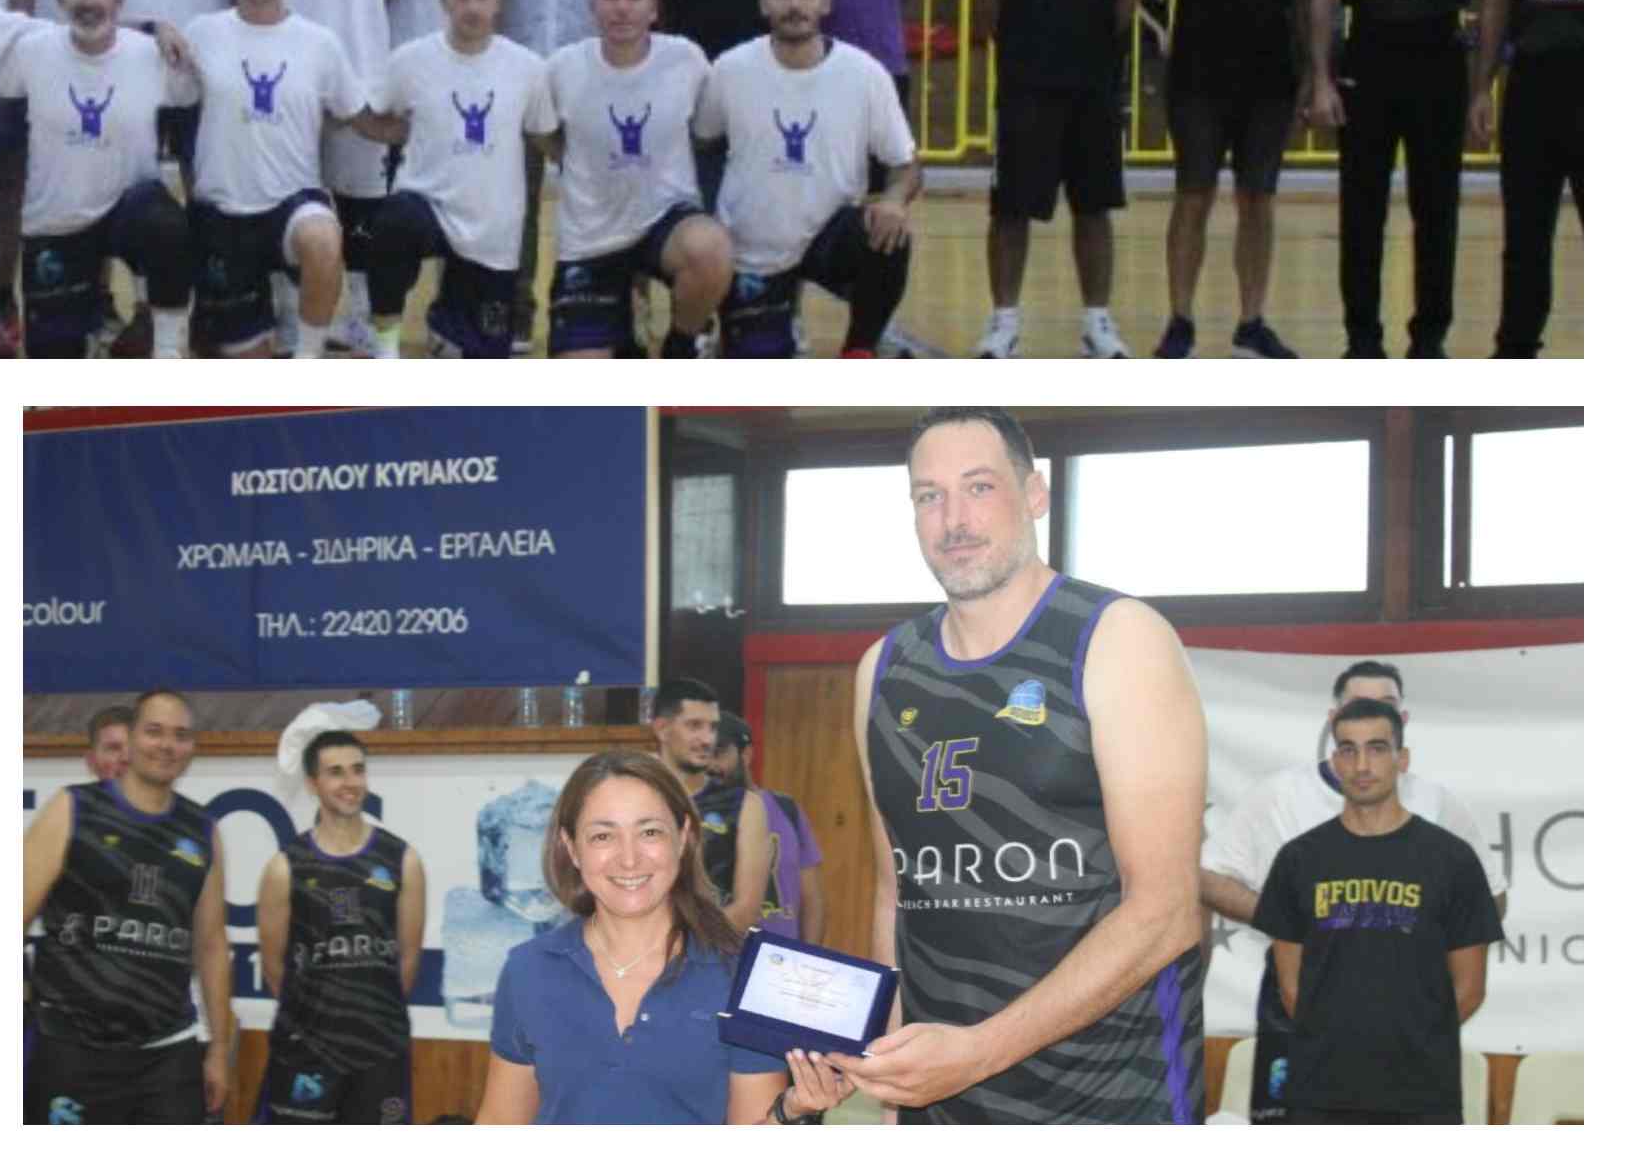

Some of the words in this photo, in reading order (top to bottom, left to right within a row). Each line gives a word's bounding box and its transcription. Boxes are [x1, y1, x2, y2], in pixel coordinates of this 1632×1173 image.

[231, 463, 369, 496] ΚΩΣΤΟΓΛΟΥ
[375, 456, 499, 488] ΚΥΡΙΑΚΟΣ
[177, 541, 291, 569] ΧΡΩΜΑΤΑ
[311, 535, 417, 565] ΣΙΔΗΡΙΚΑ
[439, 529, 556, 560] ΕΡΓΑΛΕΙΑ
[322, 610, 391, 637] 22420
[395, 607, 469, 635] 22906
[917, 737, 979, 811] 15
[964, 892, 1074, 909] RESTAURANT
[1329, 878, 1422, 908] FOIVOS
